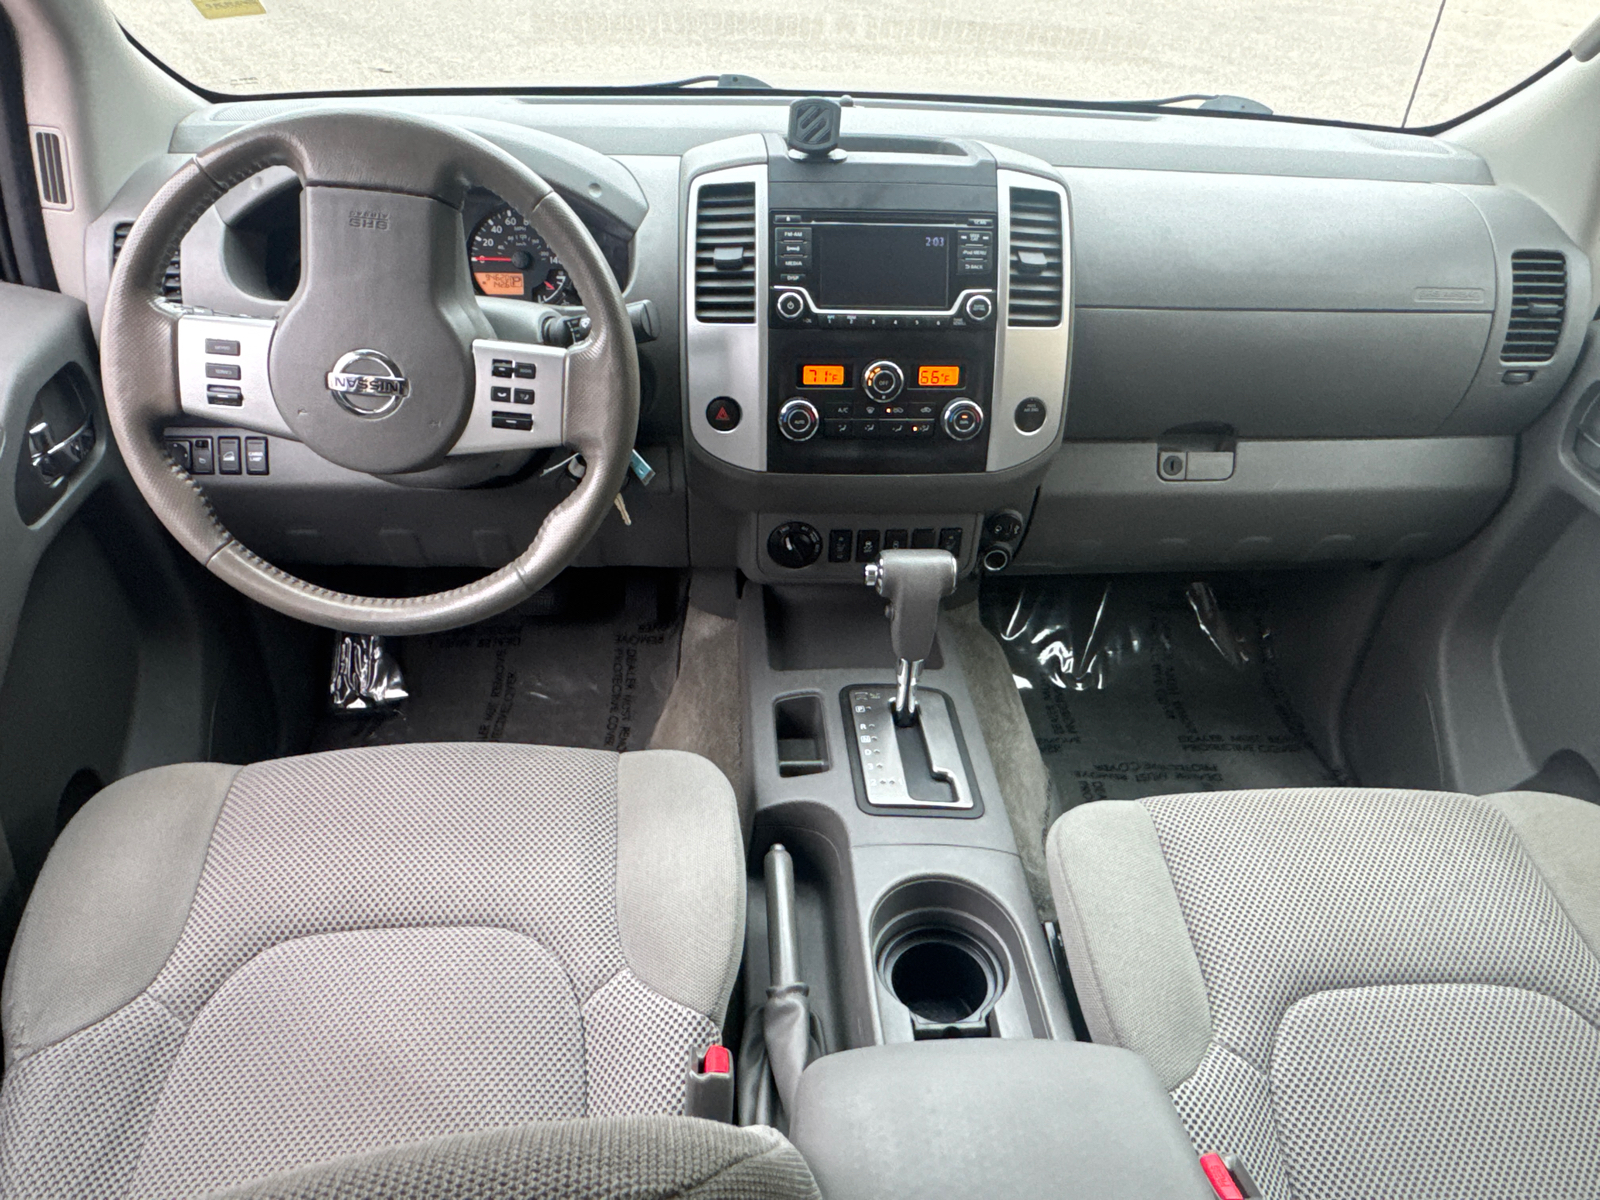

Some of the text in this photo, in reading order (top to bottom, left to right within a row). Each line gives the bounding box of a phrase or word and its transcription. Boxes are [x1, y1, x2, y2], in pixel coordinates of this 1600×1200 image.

[348, 217, 389, 230] SRS
[505, 217, 517, 226] 60
[491, 225, 503, 234] 40
[482, 238, 494, 247] 20
[925, 236, 945, 247] 2:03
[333, 375, 399, 393] NISSAN
[867, 762, 874, 770] 3
